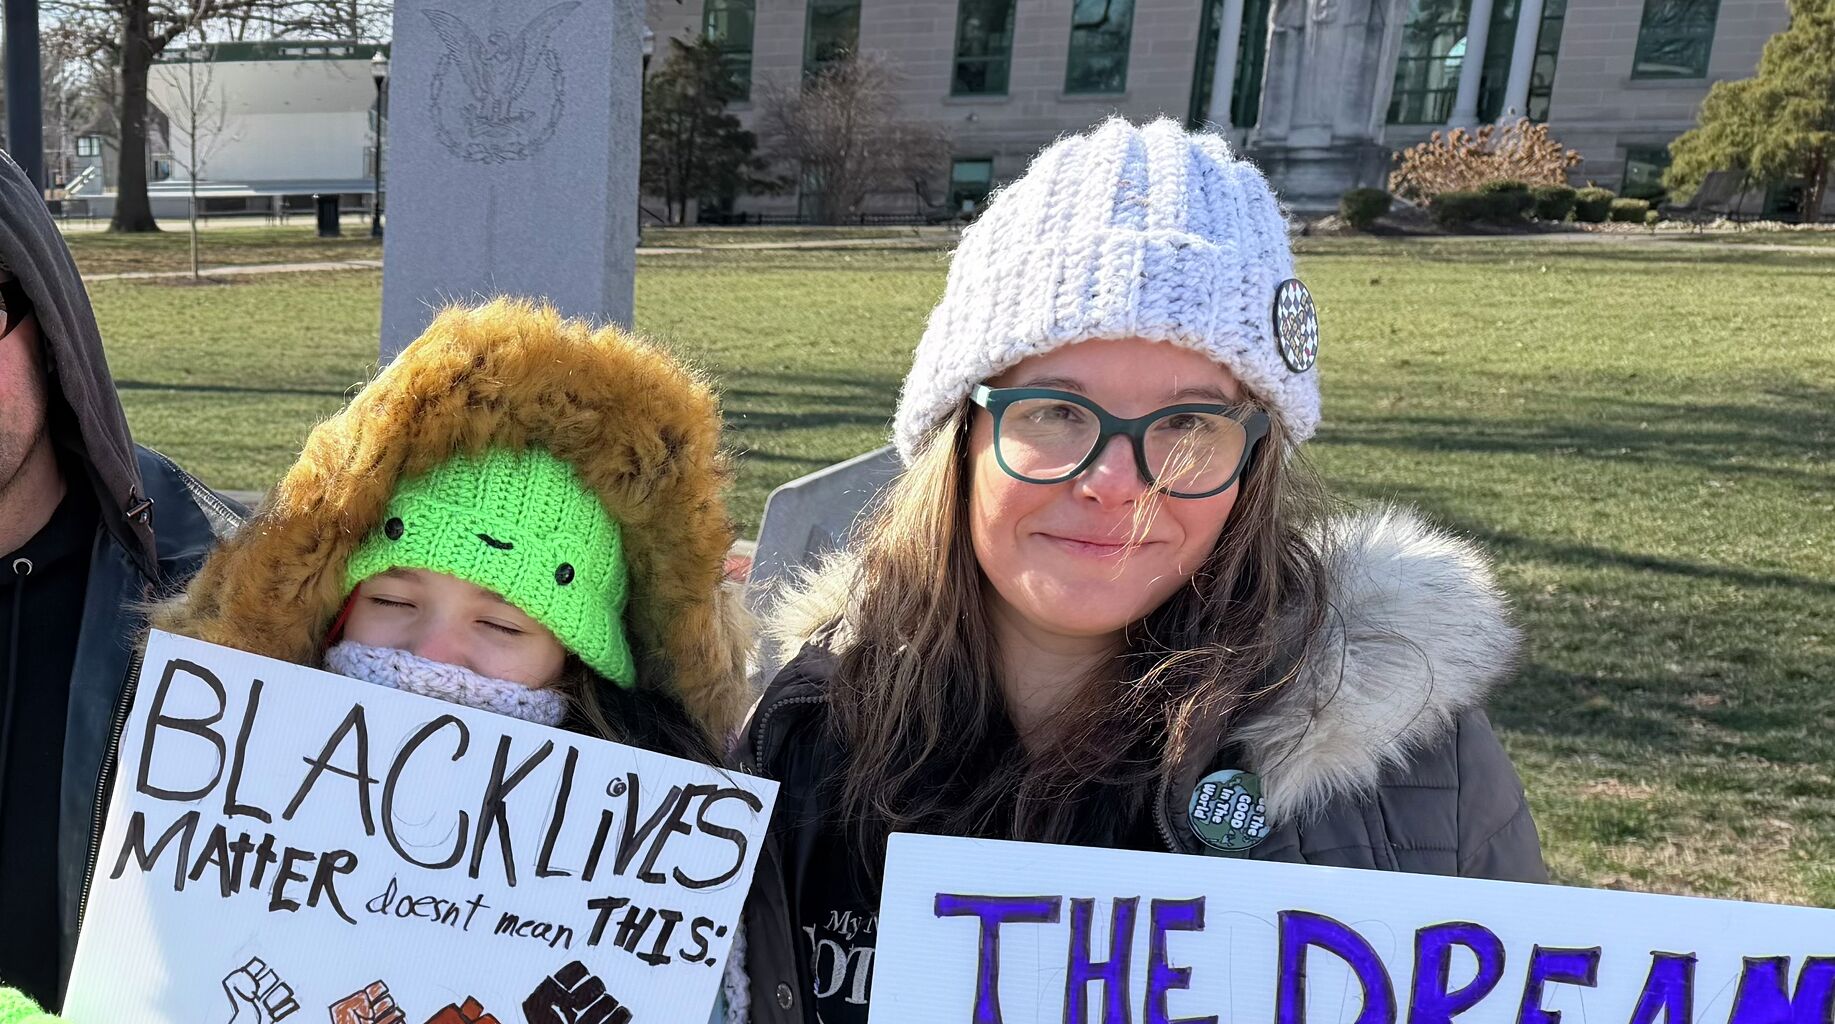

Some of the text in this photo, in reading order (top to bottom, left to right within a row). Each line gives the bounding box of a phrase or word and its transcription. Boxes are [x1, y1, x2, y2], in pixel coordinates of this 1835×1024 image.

[137, 658, 554, 886] BLACK
[1193, 783, 1217, 819] World
[1212, 788, 1234, 824] In The
[1230, 795, 1253, 829] GOOD
[494, 911, 574, 950] mean
[587, 896, 728, 967] THIS:
[823, 910, 862, 940] My
